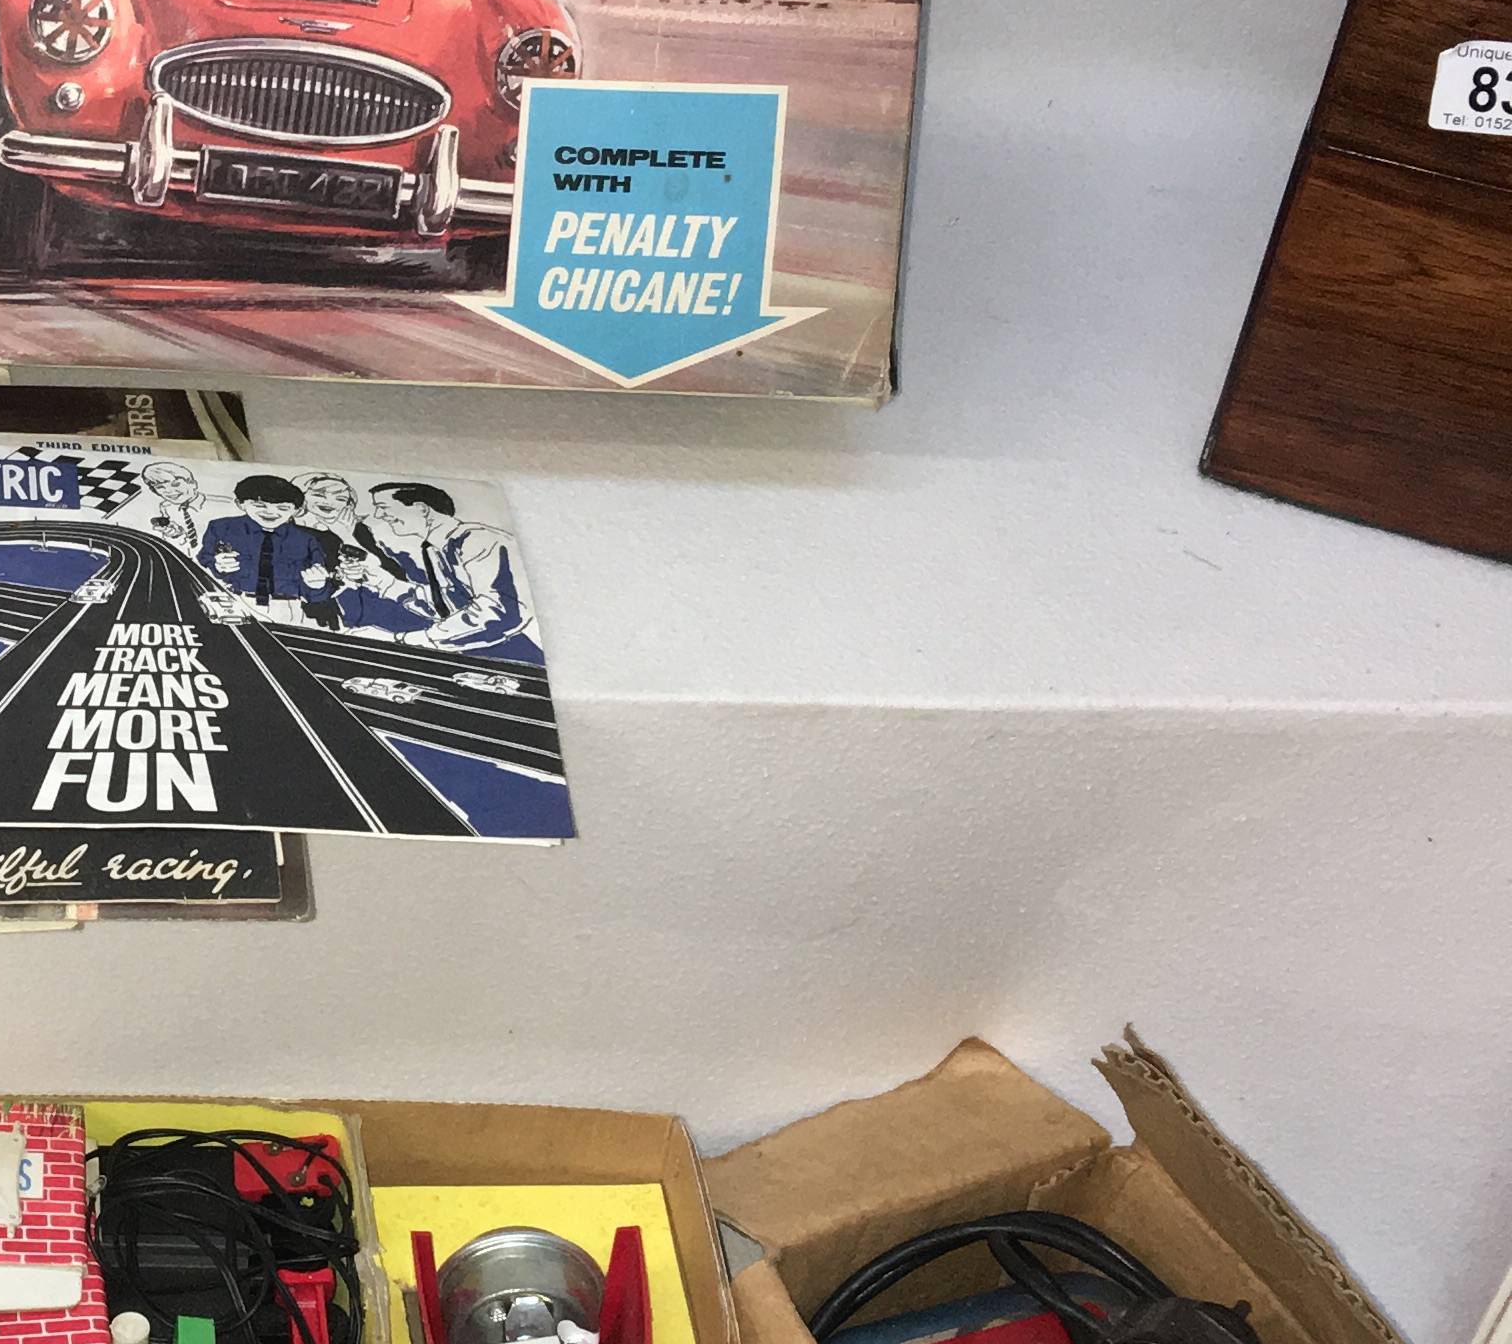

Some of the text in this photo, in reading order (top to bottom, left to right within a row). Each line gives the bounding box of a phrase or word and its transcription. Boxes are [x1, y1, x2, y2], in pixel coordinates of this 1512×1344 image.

[553, 145, 727, 170] COMPLETE
[552, 173, 632, 194] WITH
[544, 211, 739, 259] PENALTY
[537, 266, 743, 316] CHICANE!
[35, 441, 153, 455] THIRD EDITION
[106, 622, 199, 647] MORE
[93, 647, 201, 674] TRACK
[56, 673, 230, 711] MEANS
[46, 709, 230, 753] MORE
[32, 750, 219, 813] FUN
[100, 848, 252, 899] racing.
